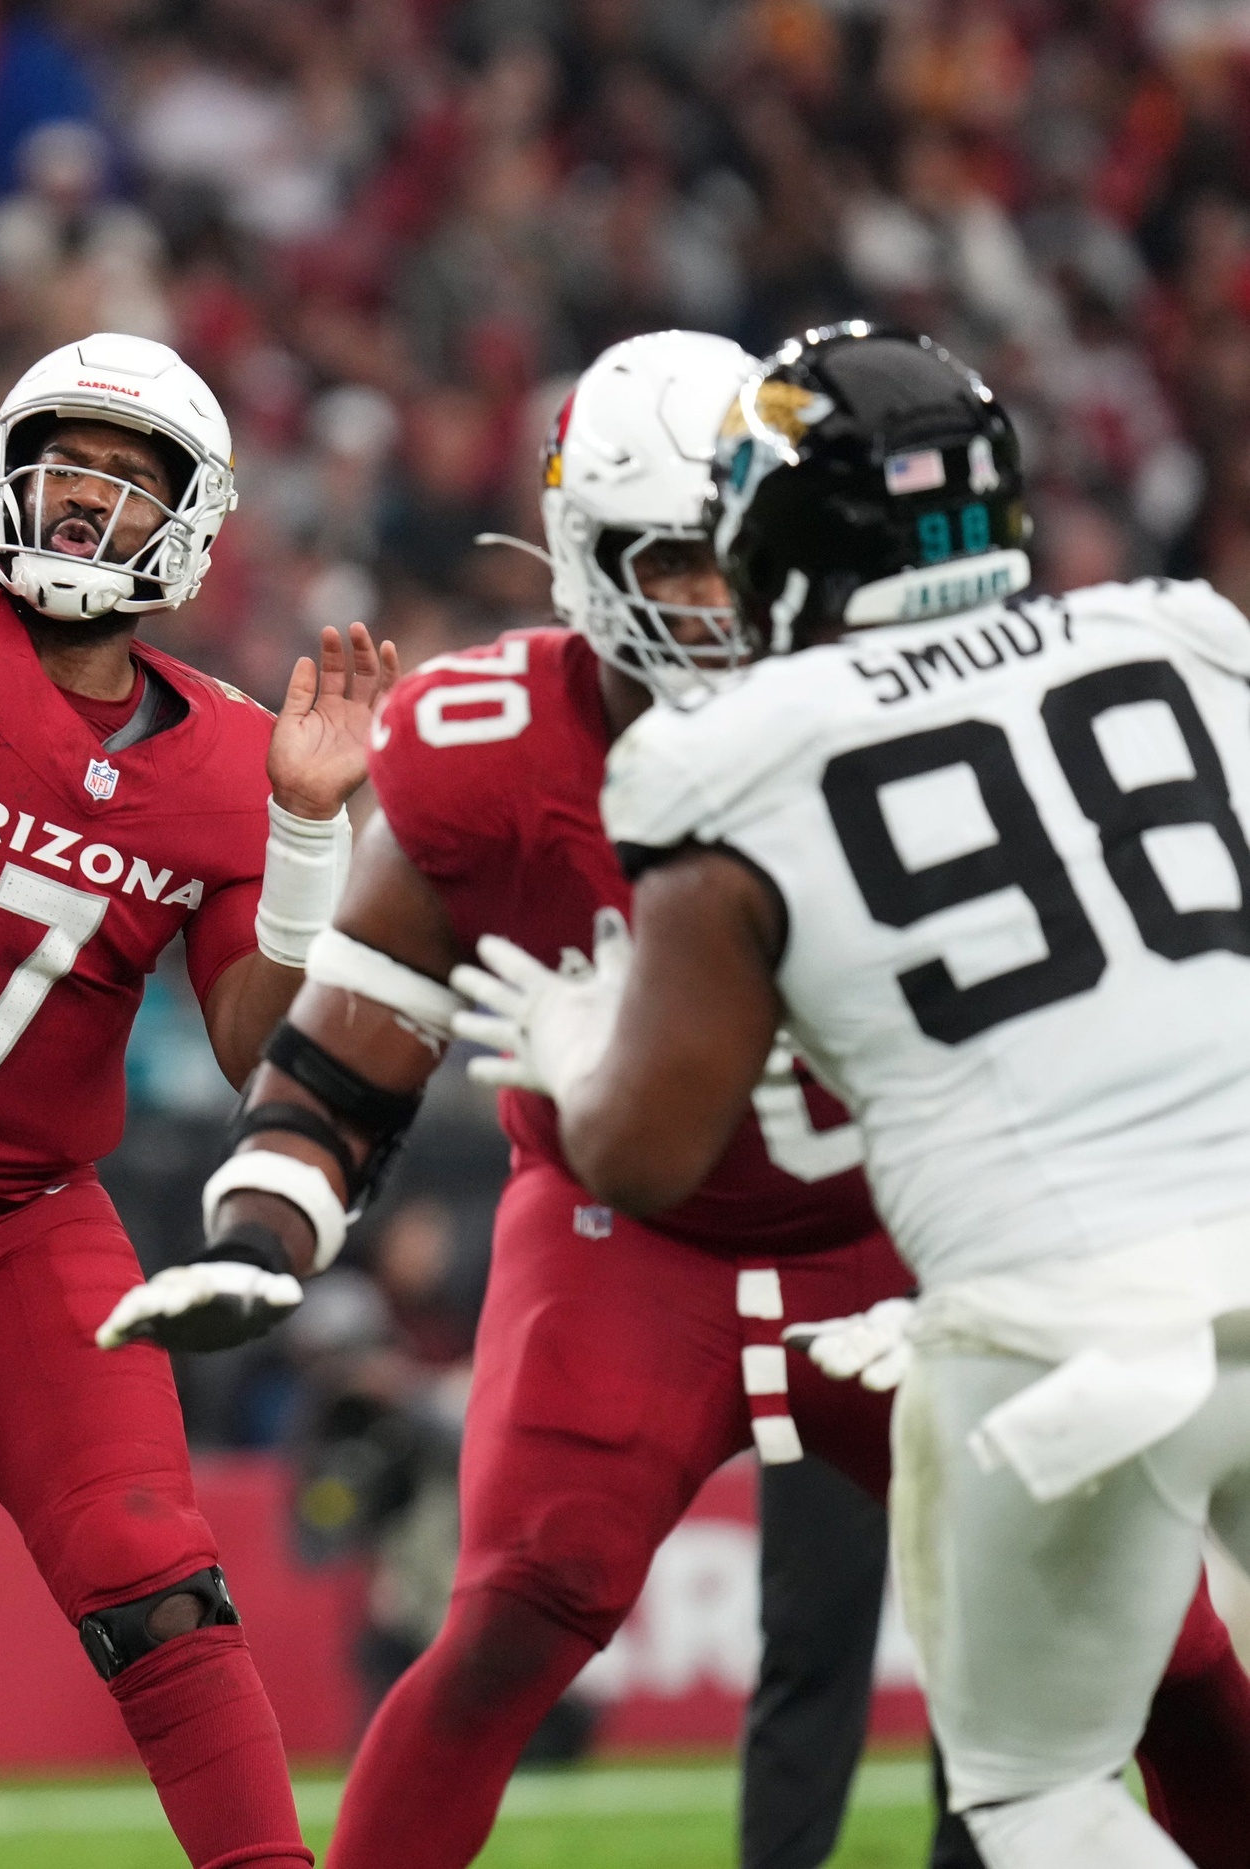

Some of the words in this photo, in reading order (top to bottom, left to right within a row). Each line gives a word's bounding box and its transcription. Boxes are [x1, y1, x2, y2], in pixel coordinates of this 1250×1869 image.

[77, 380, 140, 398] CARDINALS
[917, 503, 990, 563] 98
[414, 639, 532, 749] 70
[821, 658, 1250, 1050] 98
